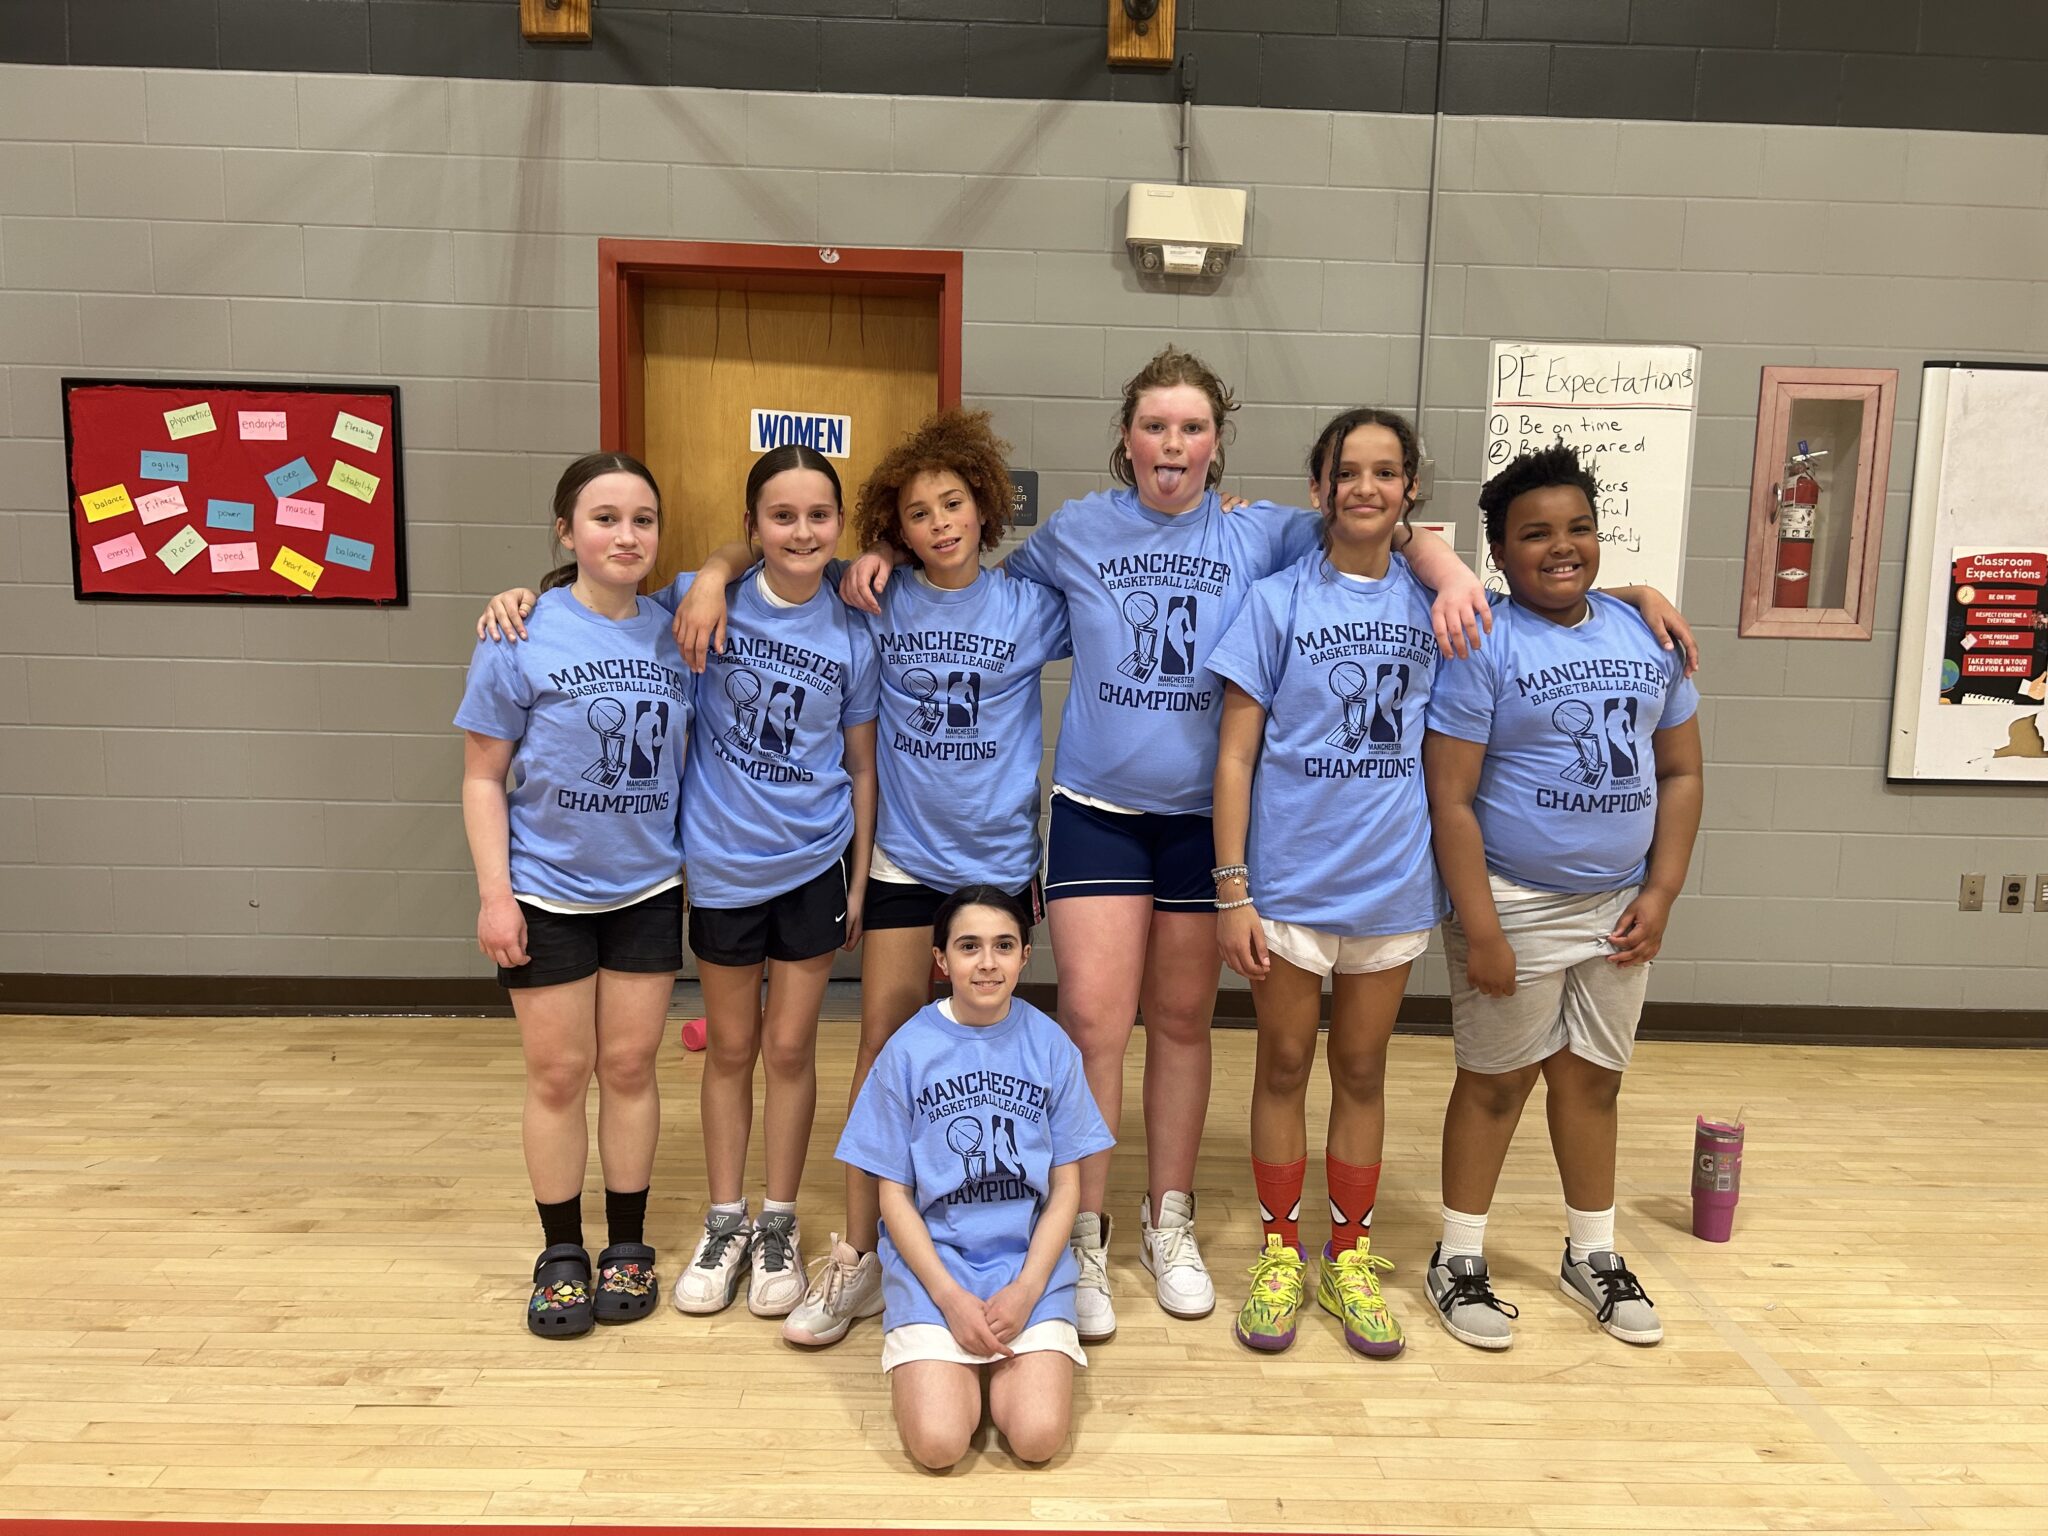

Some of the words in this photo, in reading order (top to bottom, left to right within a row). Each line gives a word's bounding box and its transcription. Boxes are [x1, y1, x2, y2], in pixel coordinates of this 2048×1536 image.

[1498, 354, 1538, 398] PE
[1546, 356, 1694, 402] Expectations
[758, 413, 843, 454] WOMEN
[1519, 415, 1544, 434] Be
[1553, 423, 1573, 434] on
[1580, 416, 1622, 432] time
[1519, 439, 1540, 455] Be
[151, 461, 180, 472] agility
[93, 495, 125, 510] balance
[217, 510, 240, 520] power
[286, 505, 316, 516] muscle
[1597, 526, 1641, 553] safely
[107, 546, 134, 559] energy
[283, 557, 302, 571] heart
[335, 545, 368, 562] balance
[1974, 556, 2032, 566] Classroom
[1098, 554, 1231, 586] MANCHESTER
[1108, 575, 1182, 590] BASKETBALL
[1966, 567, 2041, 581] Expectations
[879, 631, 1016, 663] MANCHESTER
[1295, 621, 1438, 661] MANCHESTER
[708, 637, 842, 688] ANCHESTE
[888, 652, 960, 665] BASKETBALL
[961, 653, 1005, 674] LEAGUE
[1309, 643, 1389, 665] BASKETBALL
[1391, 645, 1431, 668] LEAGUE
[789, 667, 833, 696] LEAGUE
[1158, 675, 1195, 683] MANCHESTER
[1516, 659, 1666, 697] MANCHESTER
[567, 681, 647, 699] BASKETBALL
[648, 683, 687, 706] LEAGUE
[1099, 682, 1211, 712] CHAMPIONS
[1531, 680, 1613, 706] BASKETBALL
[1615, 680, 1660, 699] LEAGUE
[893, 732, 997, 761] CHAMPIONS
[1304, 757, 1415, 778] CHAMPIONS
[558, 789, 669, 815] CHAMPIONS
[1536, 786, 1651, 814] CHAMPIONS
